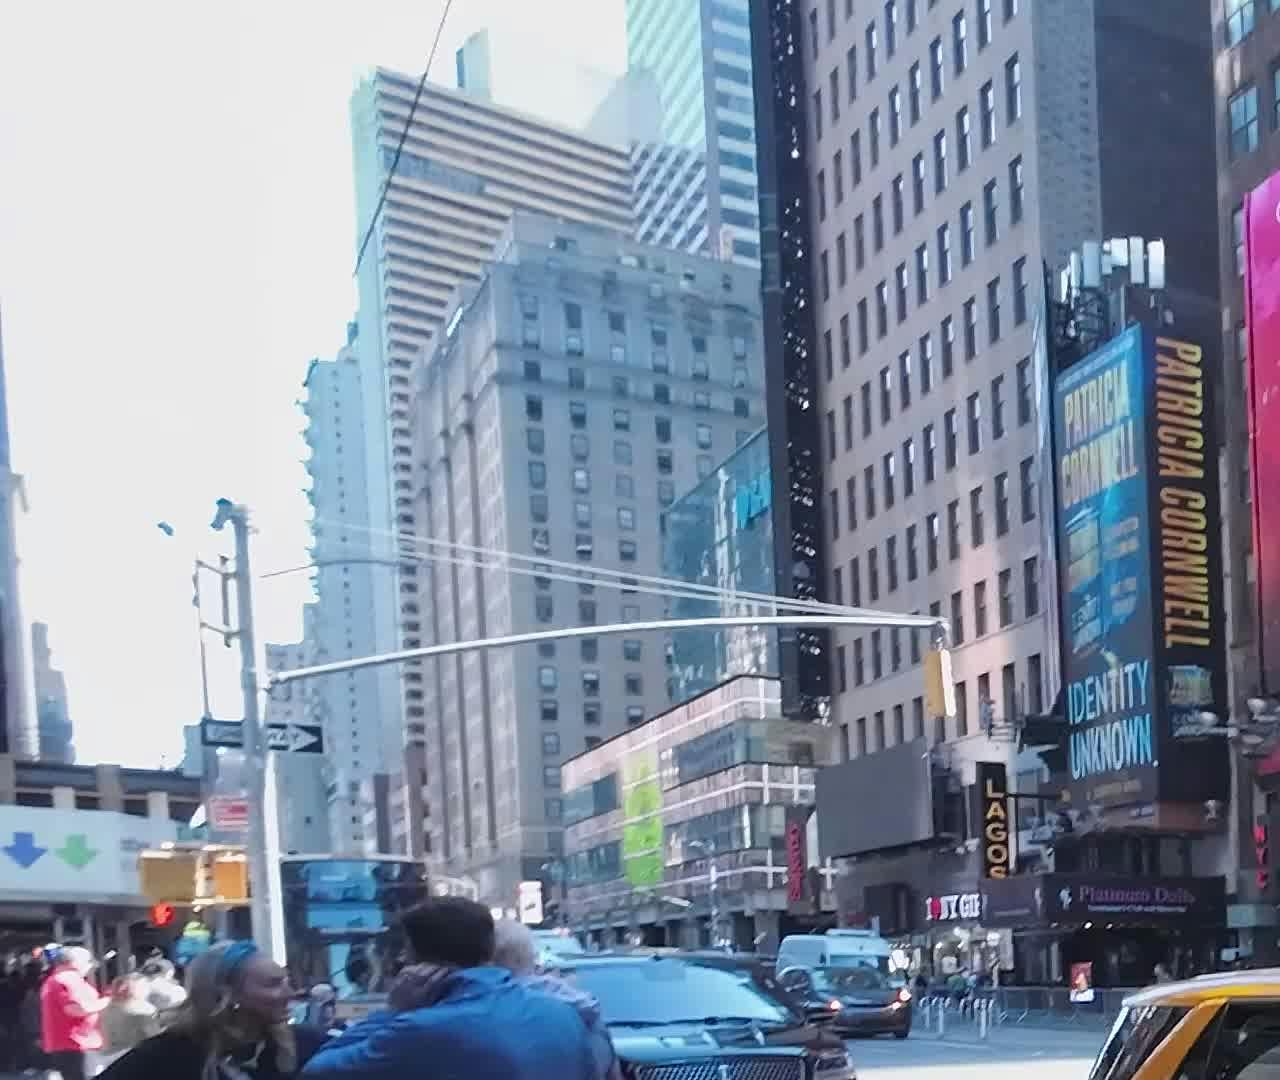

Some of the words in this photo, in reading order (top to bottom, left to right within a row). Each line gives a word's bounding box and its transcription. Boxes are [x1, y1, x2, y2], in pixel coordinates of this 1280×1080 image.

[1064, 358, 1130, 449] PATRICIA
[1156, 333, 1203, 478] PATRICIA
[1061, 419, 1138, 509] CORNWELL
[1160, 487, 1211, 649] CORNWELL
[1067, 659, 1149, 726] IDENTITY
[1070, 713, 1160, 780] UNKNOWN.
